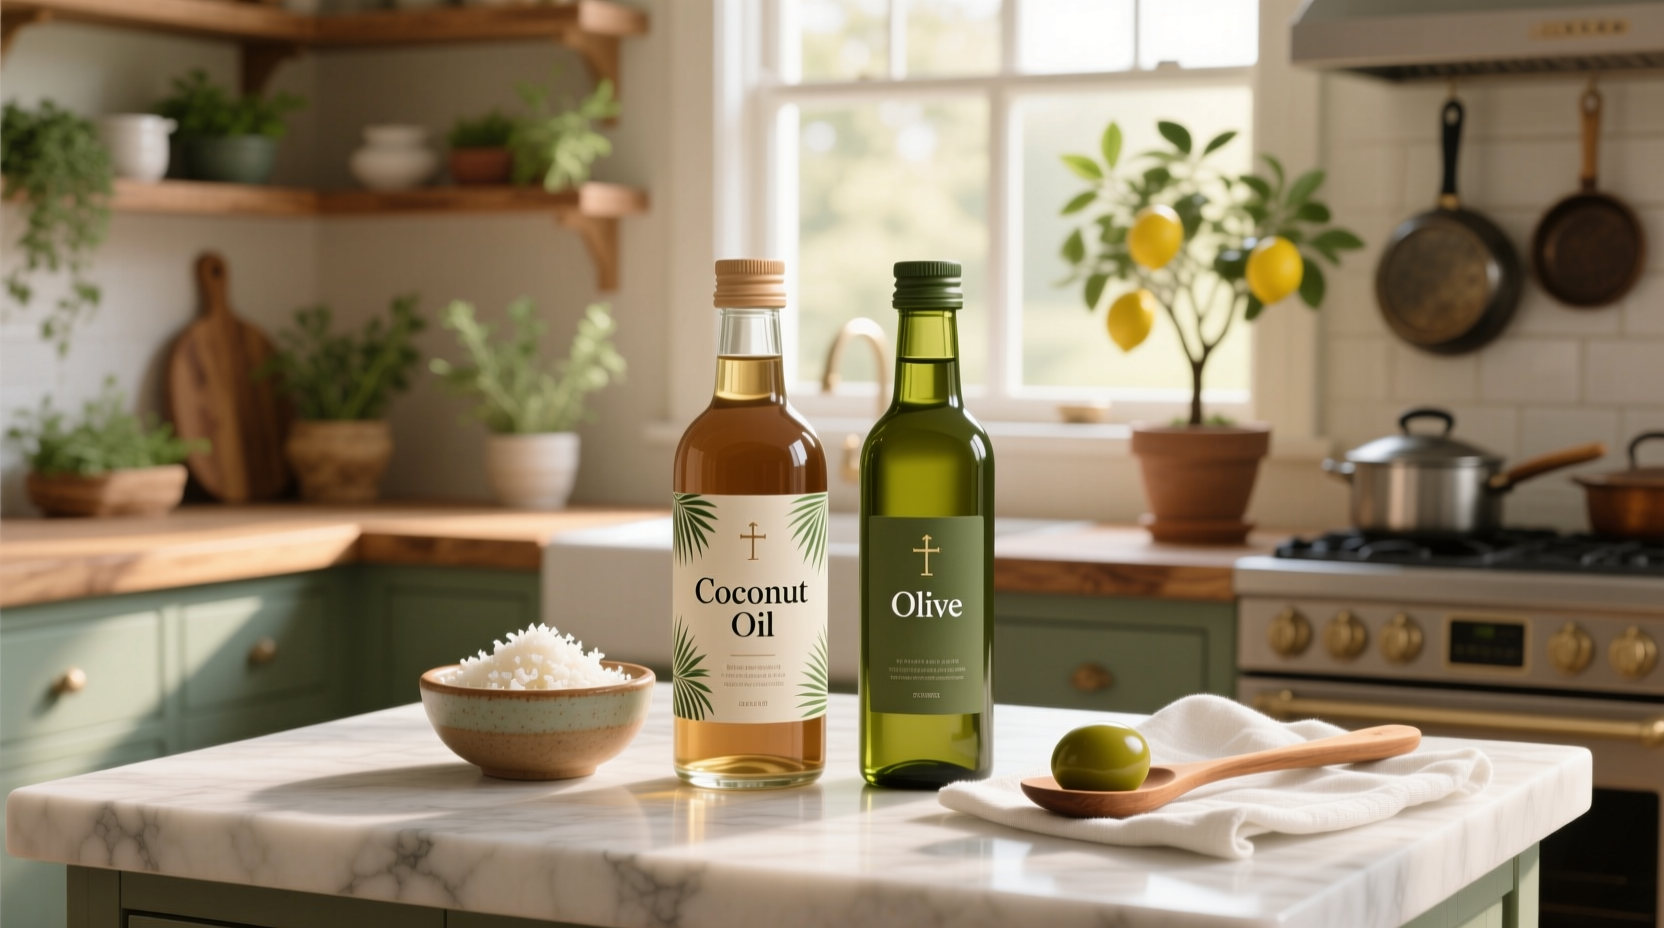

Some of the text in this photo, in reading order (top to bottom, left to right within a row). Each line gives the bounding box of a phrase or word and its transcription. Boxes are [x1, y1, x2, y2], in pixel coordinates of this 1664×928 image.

[694, 576, 808, 605] Coconut
[891, 590, 963, 619] Olive
[731, 610, 775, 638] Oil
